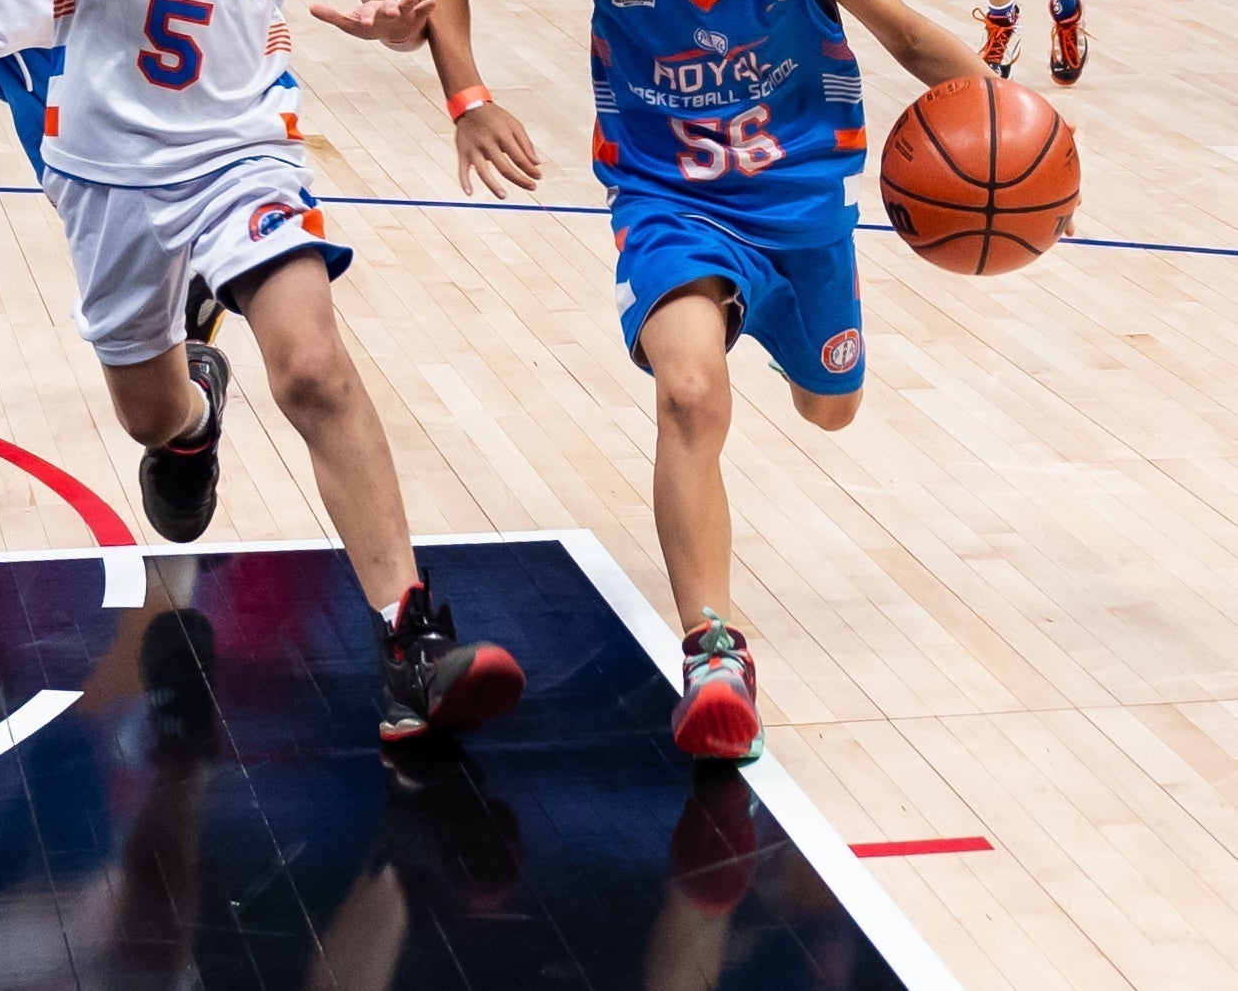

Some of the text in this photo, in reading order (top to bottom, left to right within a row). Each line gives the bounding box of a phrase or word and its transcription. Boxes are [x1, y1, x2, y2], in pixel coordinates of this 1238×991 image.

[653, 51, 773, 93] ROYAL
[748, 58, 799, 100] SCHOOL
[668, 104, 786, 182] 56
